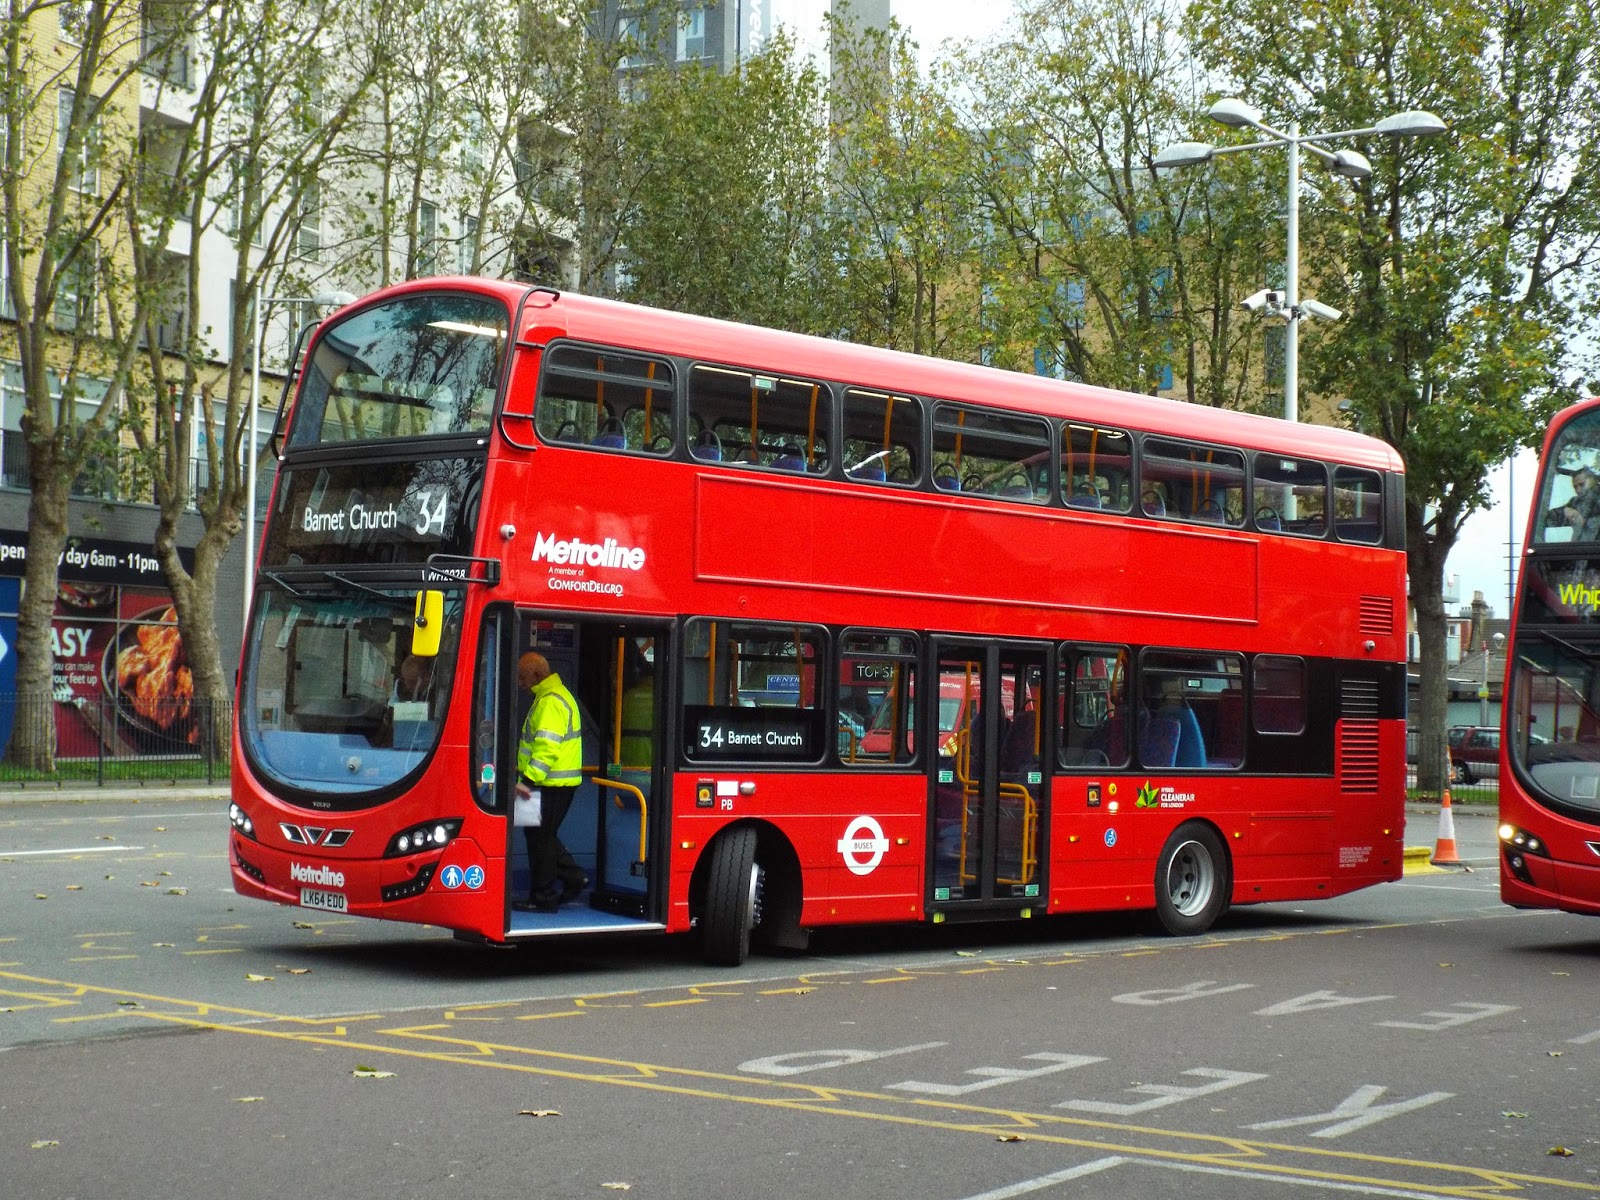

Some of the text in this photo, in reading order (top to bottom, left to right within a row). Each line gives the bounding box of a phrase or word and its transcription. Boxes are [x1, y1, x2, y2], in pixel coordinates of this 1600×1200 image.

[304, 491, 448, 535] Barnet Church 34
[0, 543, 25, 561] pen
[66, 547, 90, 569] day
[90, 549, 116, 568] 6am
[127, 553, 159, 573] 11pm
[531, 531, 646, 571] Metroline
[554, 567, 577, 576] member
[51, 627, 92, 657] ASY
[65, 663, 76, 671] can
[77, 661, 95, 672] make
[70, 673, 86, 684] feet
[87, 675, 97, 687] up
[700, 726, 802, 748] 34 Barnet Church
[721, 798, 733, 811] PB
[853, 842, 873, 850] BUSES
[290, 861, 345, 888] Metroline
[303, 889, 325, 906] LK64
[737, 1041, 1457, 1139] KEEP
